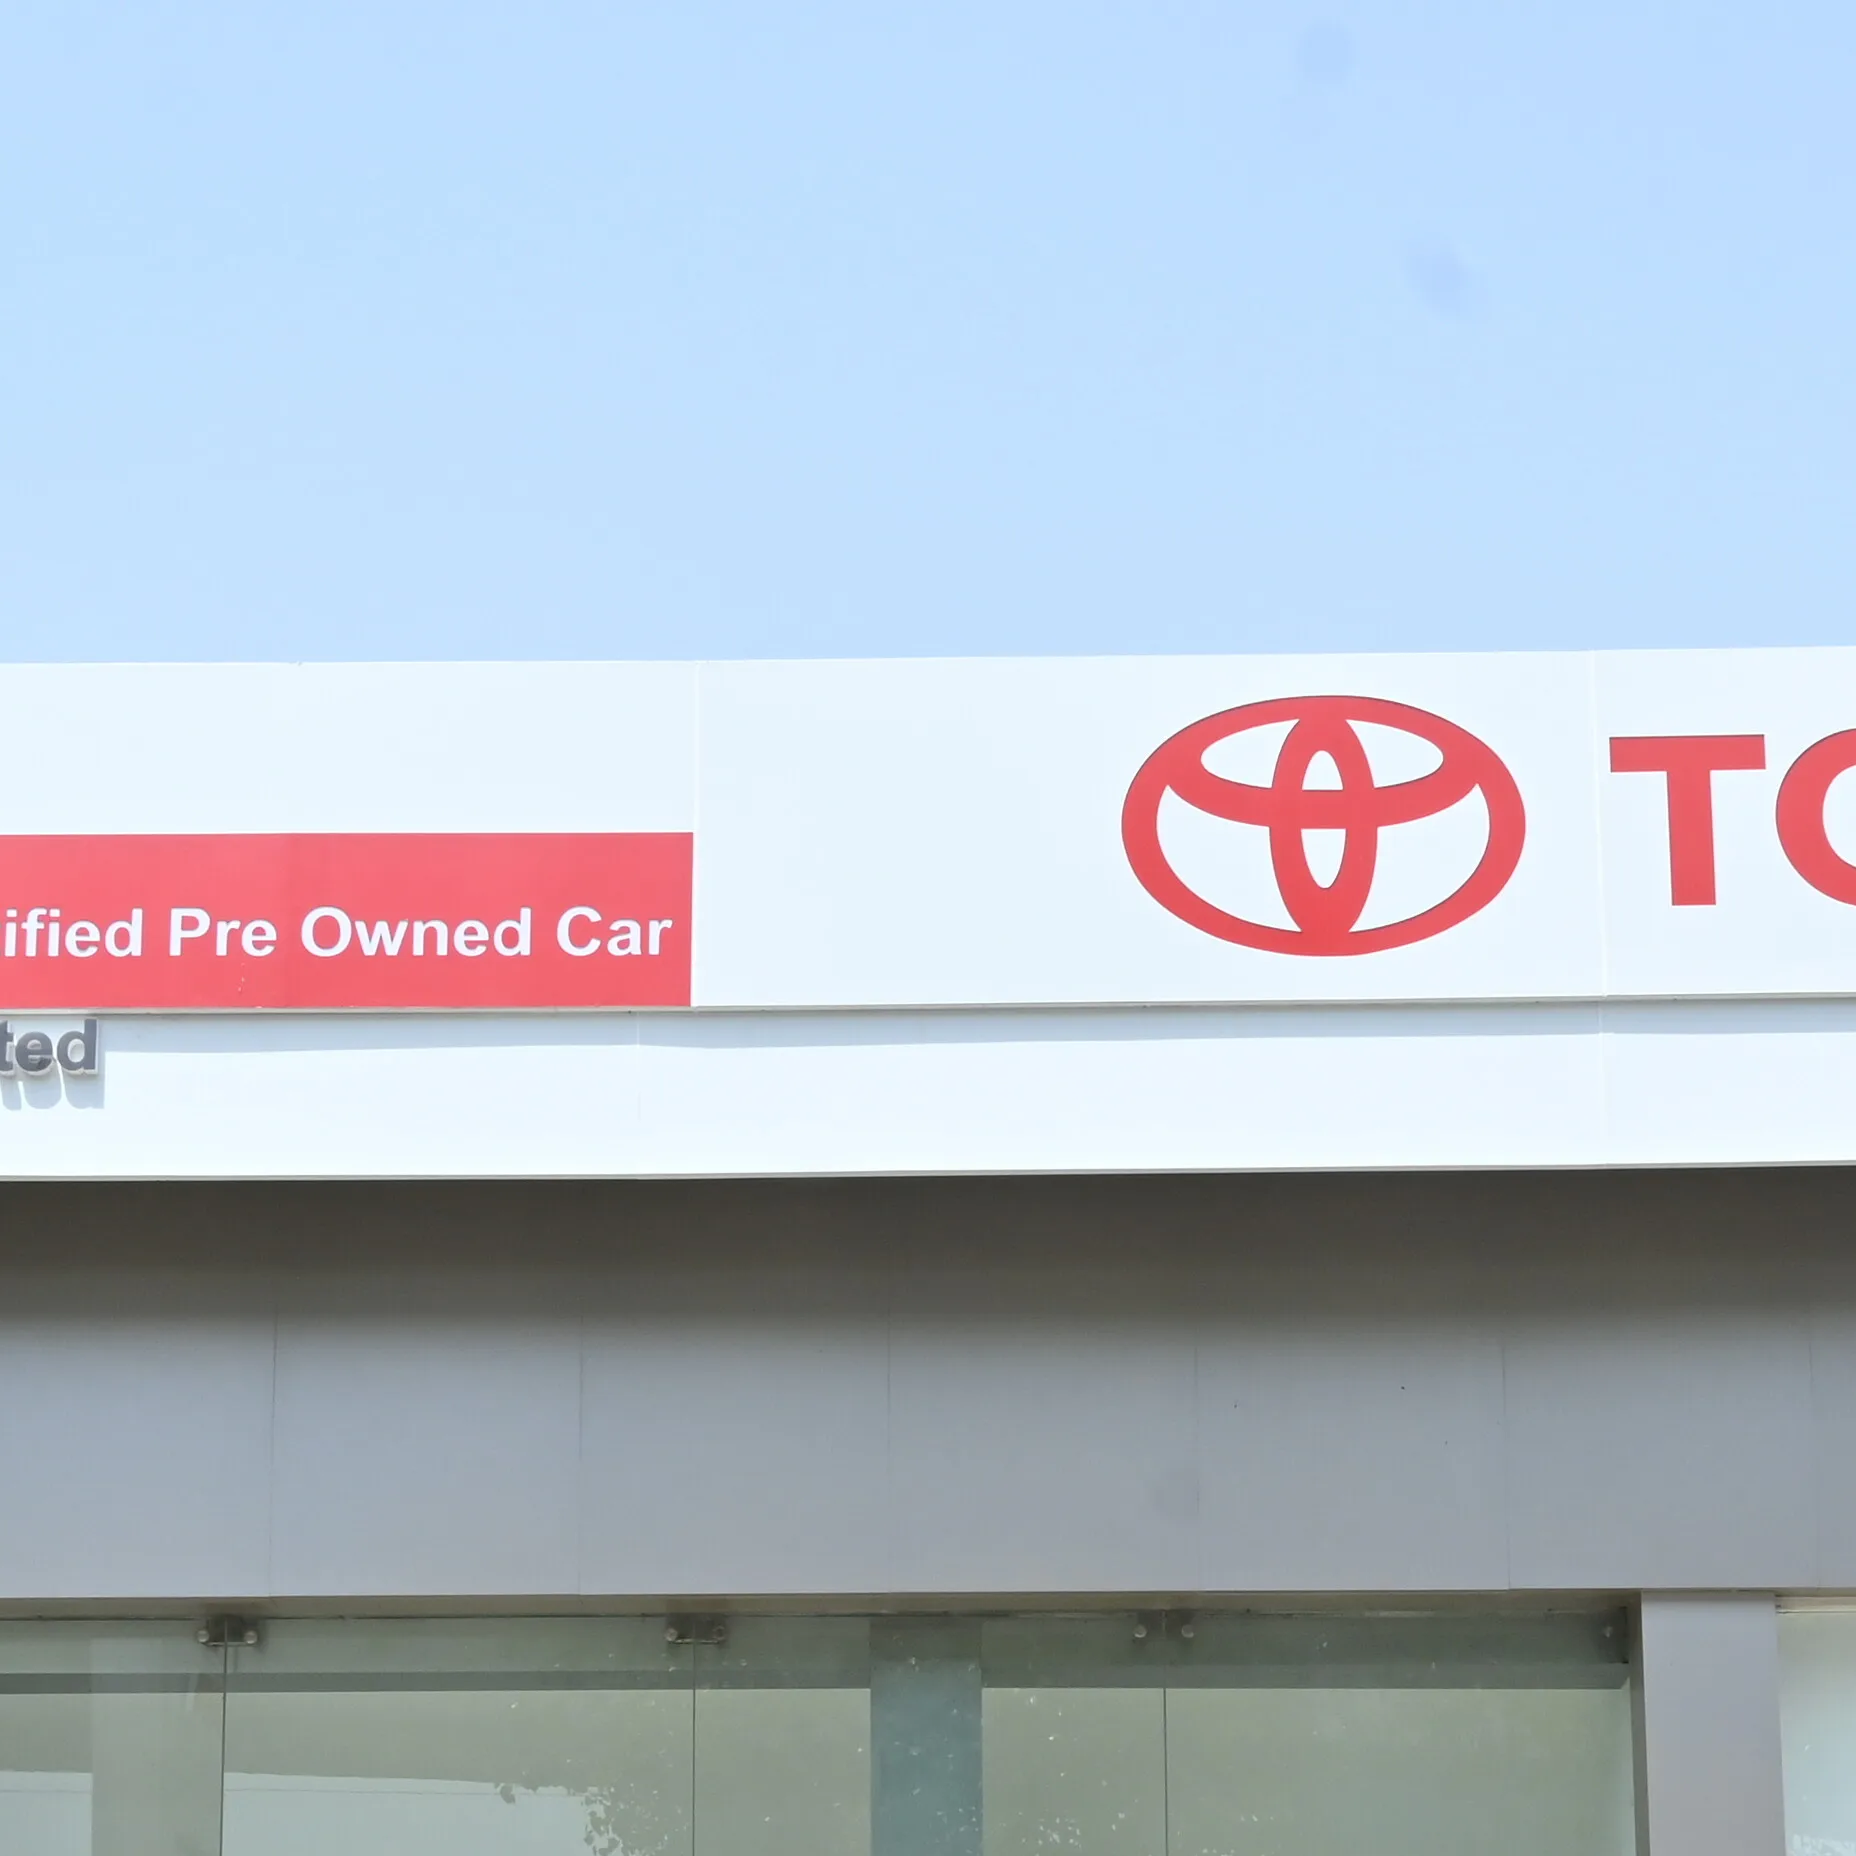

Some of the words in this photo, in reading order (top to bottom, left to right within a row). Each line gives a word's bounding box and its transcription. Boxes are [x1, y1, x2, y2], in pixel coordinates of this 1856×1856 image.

[168, 907, 277, 960] Pre
[300, 905, 533, 959] Owned
[554, 906, 674, 959] Car
